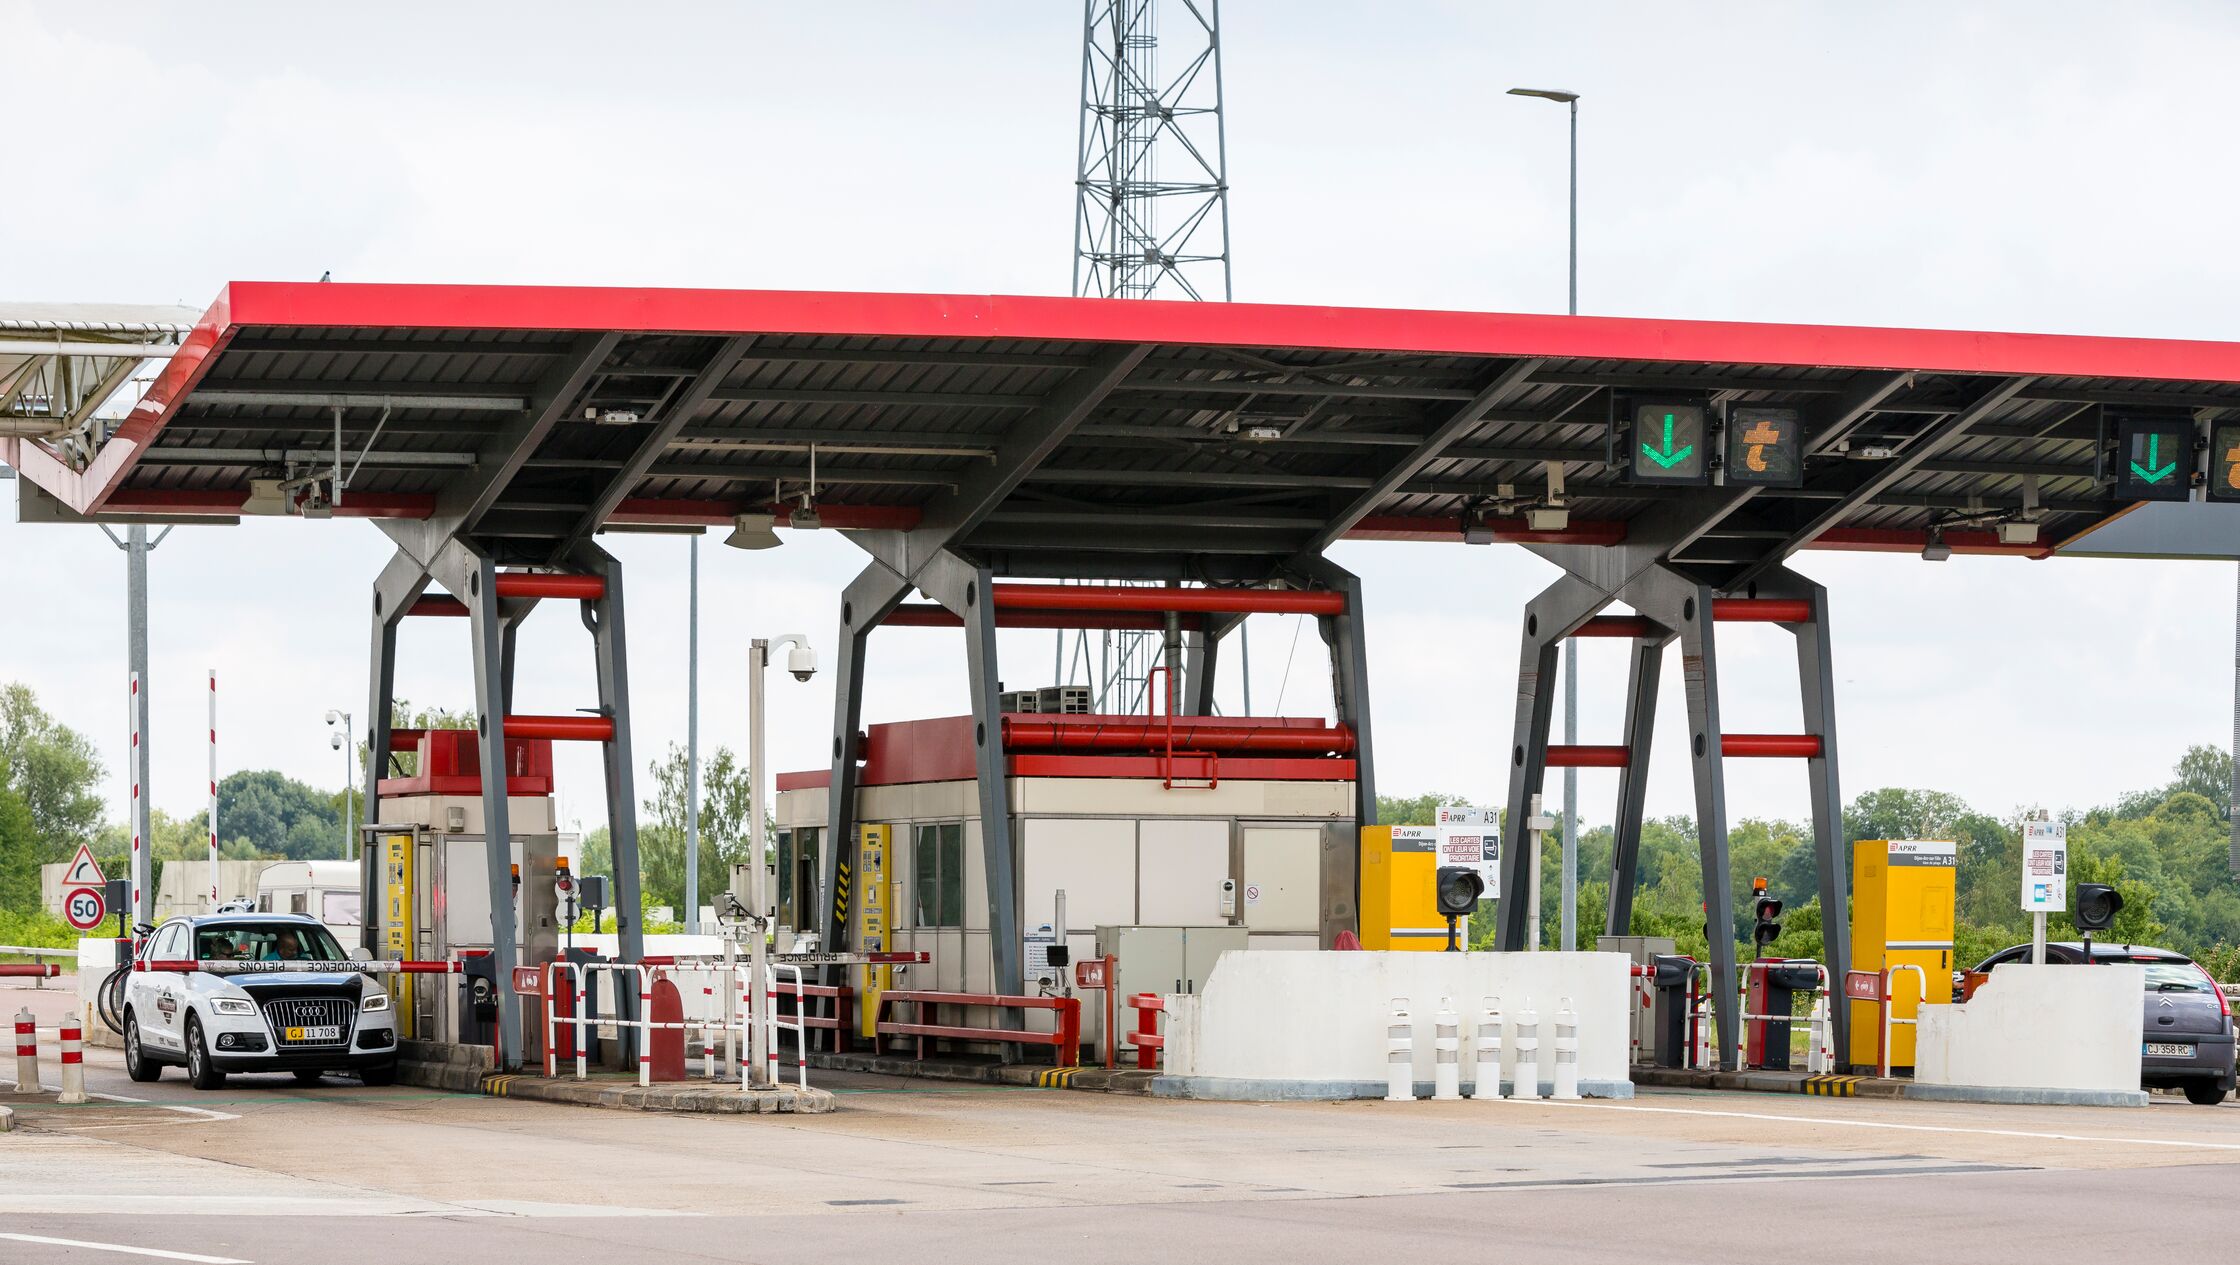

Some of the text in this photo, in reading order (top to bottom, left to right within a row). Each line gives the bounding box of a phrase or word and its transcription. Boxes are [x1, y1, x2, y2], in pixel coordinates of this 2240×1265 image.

[1449, 814, 1466, 823] APRR
[1484, 811, 1498, 824] A31
[2056, 826, 2065, 838] A31
[1942, 856, 1956, 865] A31
[73, 899, 98, 918] 50
[779, 952, 838, 962] PRUDENCE
[238, 962, 367, 972] PRUDENCE PIETONS
[290, 1027, 336, 1038] GJ 11 708
